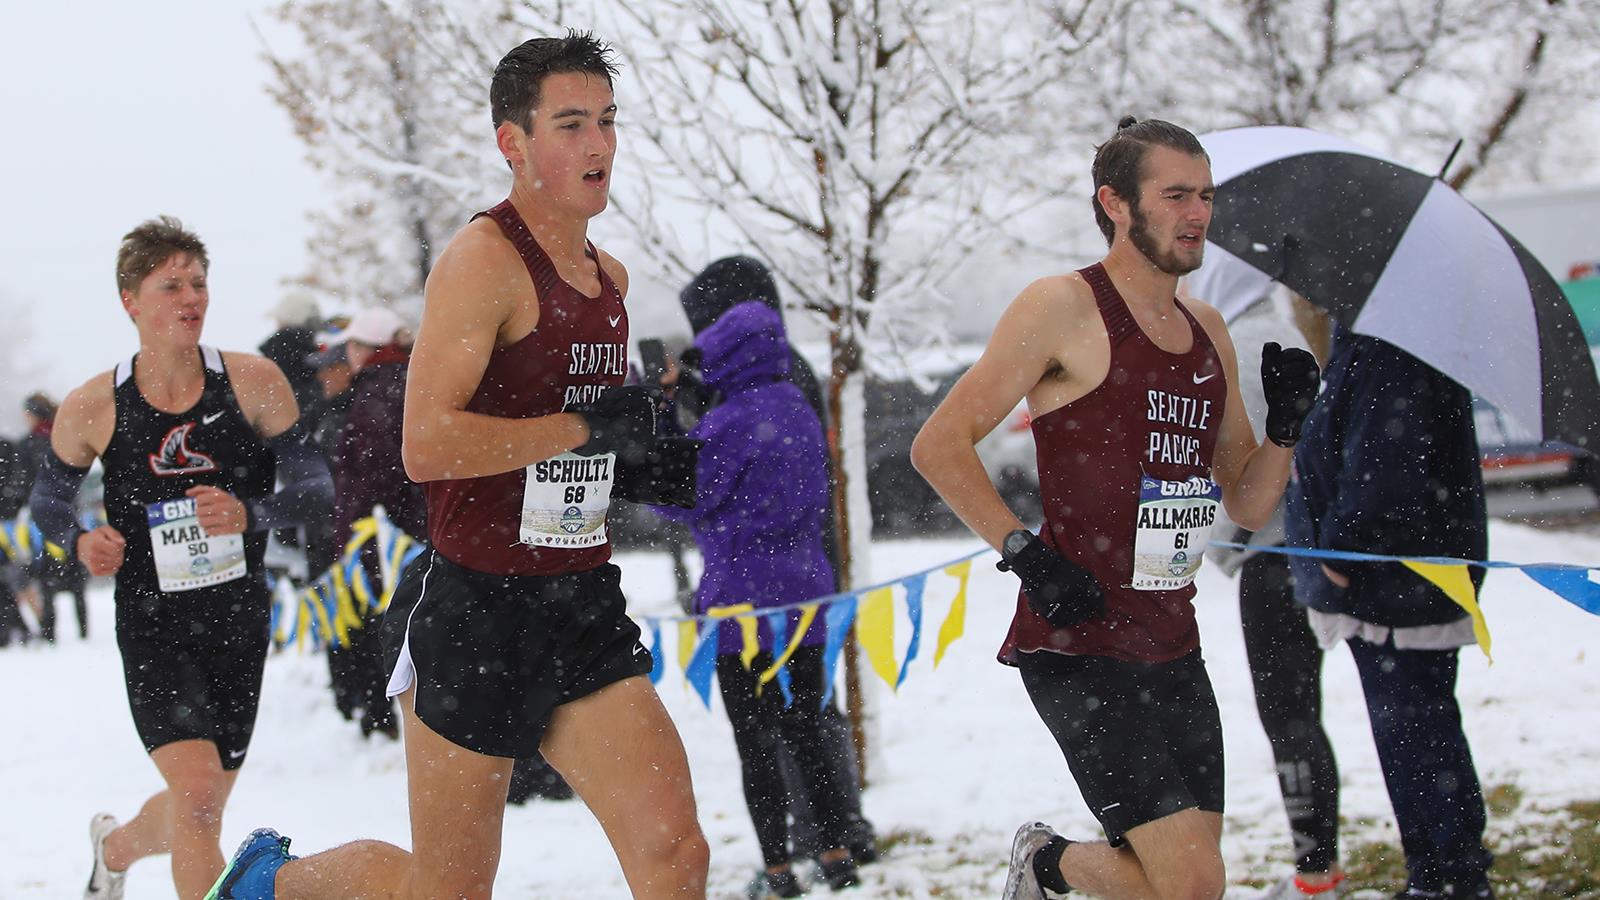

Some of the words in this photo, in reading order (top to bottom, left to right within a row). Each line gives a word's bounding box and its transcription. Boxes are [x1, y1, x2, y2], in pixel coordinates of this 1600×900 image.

[569, 343, 624, 375] SEATTLE
[561, 384, 611, 413] PACI
[1147, 390, 1211, 430] SEATTLE
[535, 458, 609, 483] SCHULTZ
[564, 485, 586, 504] 68
[1160, 477, 1212, 496] GNAC
[162, 498, 198, 520] GN
[1138, 505, 1216, 530] ALLMARAS
[1174, 532, 1189, 550] 61
